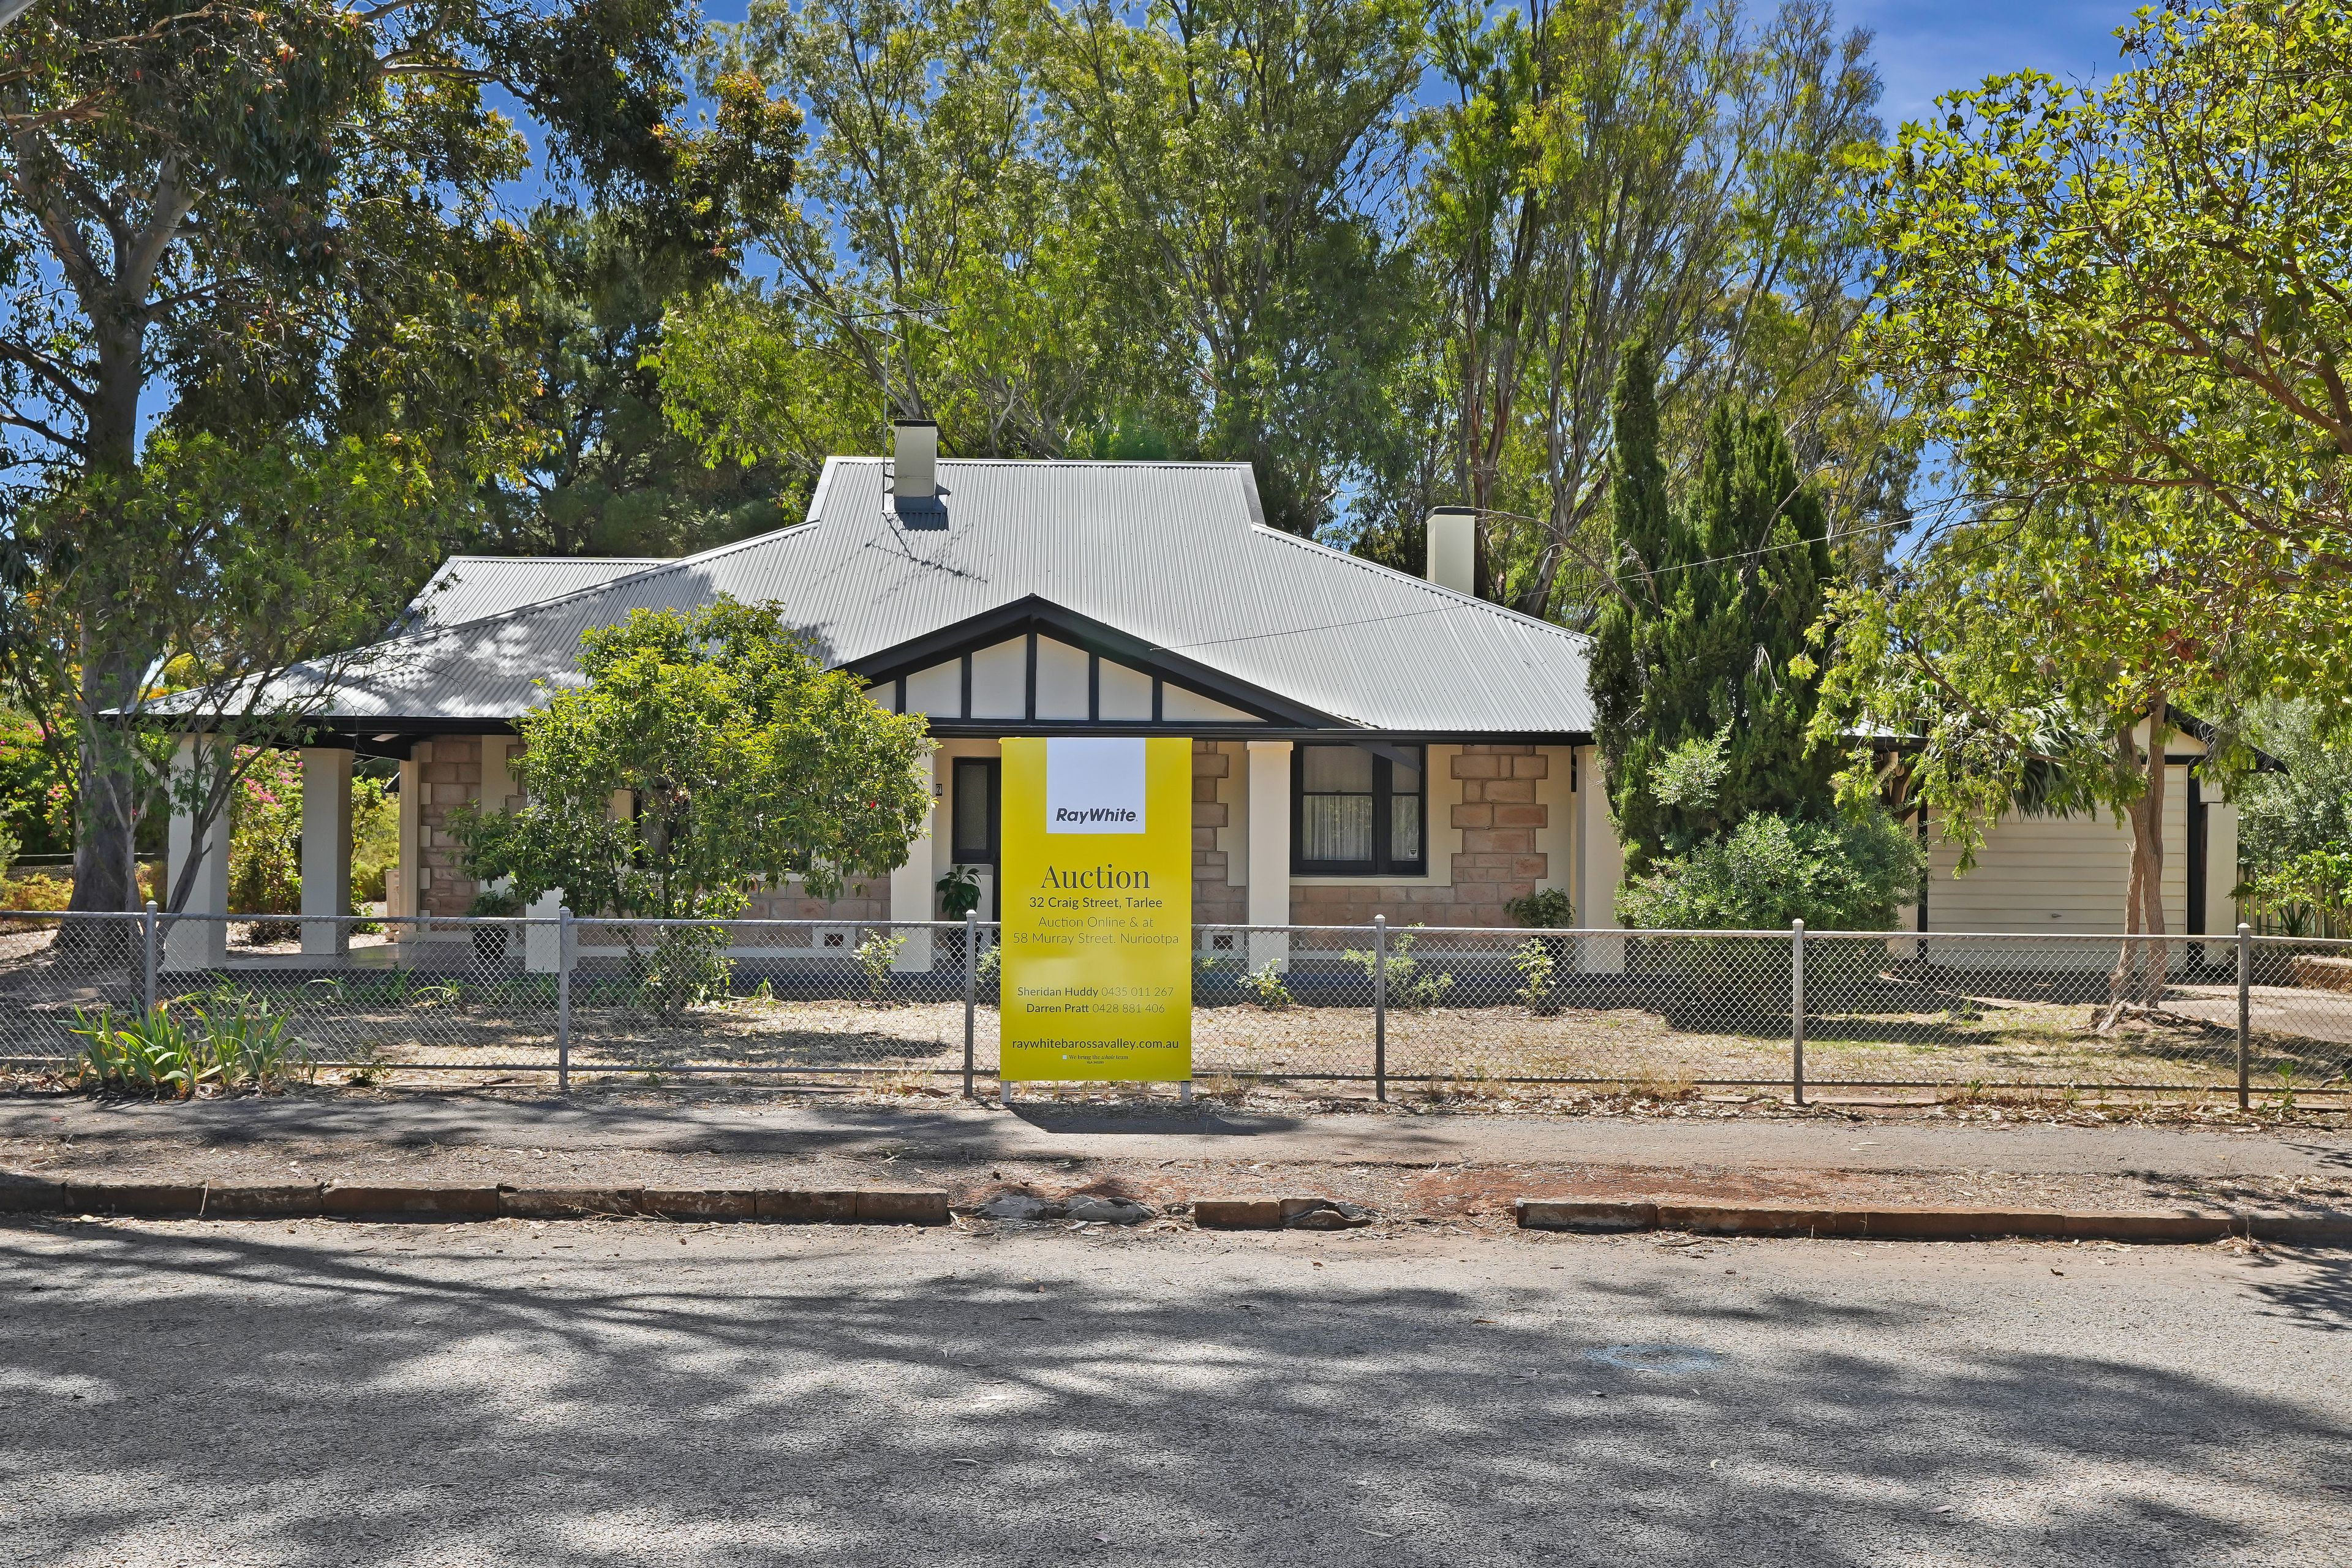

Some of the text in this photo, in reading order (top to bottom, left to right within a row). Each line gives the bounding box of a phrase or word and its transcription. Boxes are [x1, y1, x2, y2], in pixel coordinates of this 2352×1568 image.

[1041, 864, 1150, 889] Auction
[1030, 897, 1163, 910] 32 Craig Street, Tarlee
[1038, 917, 1153, 927] Auction Online & at
[1013, 933, 1028, 943] 58
[1033, 933, 1074, 945] Murray
[1121, 933, 1178, 946] Nuriootpa
[1017, 987, 1174, 998] Sheridan Huddy 0435 011 267
[1027, 1004, 1164, 1012] Darren Pratt 0428 881 406
[1012, 1038, 1178, 1050] raywhitebarossavalley.com.au
